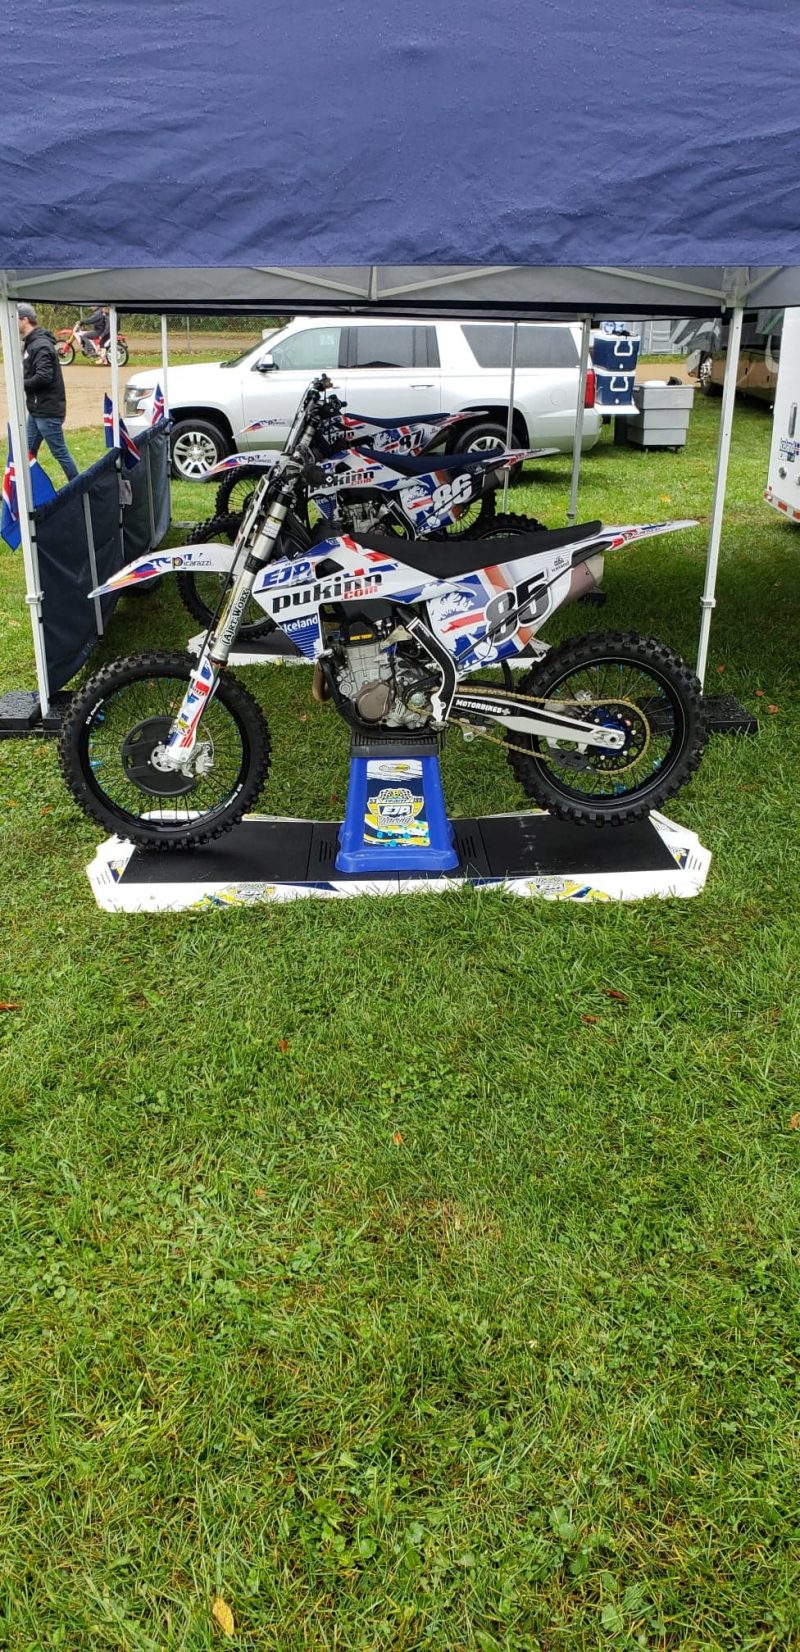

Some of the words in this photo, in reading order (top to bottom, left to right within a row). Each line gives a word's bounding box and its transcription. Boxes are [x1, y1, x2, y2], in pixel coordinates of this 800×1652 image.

[432, 473, 472, 516] 86
[272, 574, 383, 614] pukinn
[484, 568, 552, 646] 85
[282, 615, 319, 633] Iceland
